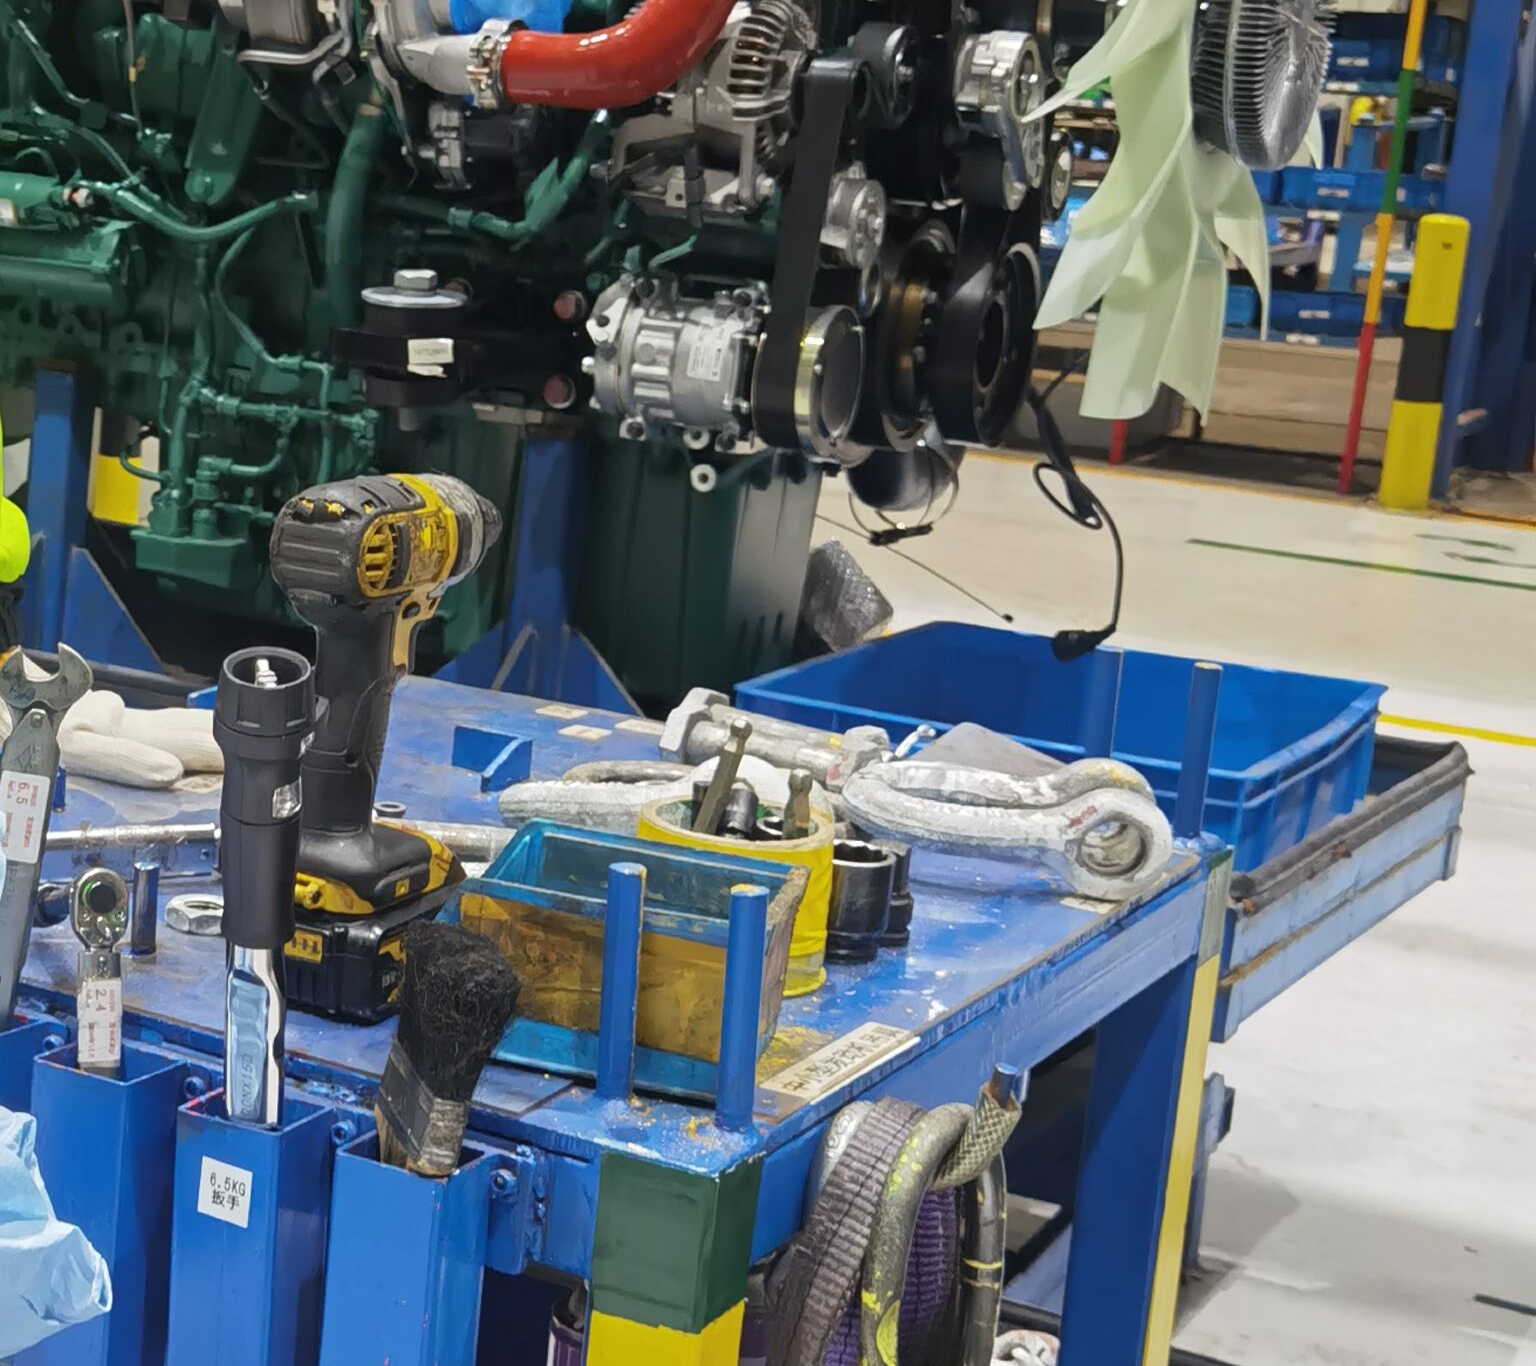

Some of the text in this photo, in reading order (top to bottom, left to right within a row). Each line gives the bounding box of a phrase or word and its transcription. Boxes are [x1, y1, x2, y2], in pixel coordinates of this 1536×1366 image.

[15, 781, 30, 805] 6.5
[210, 1172, 246, 1196] 6.5KG
[211, 1188, 240, 1211] 扳手
